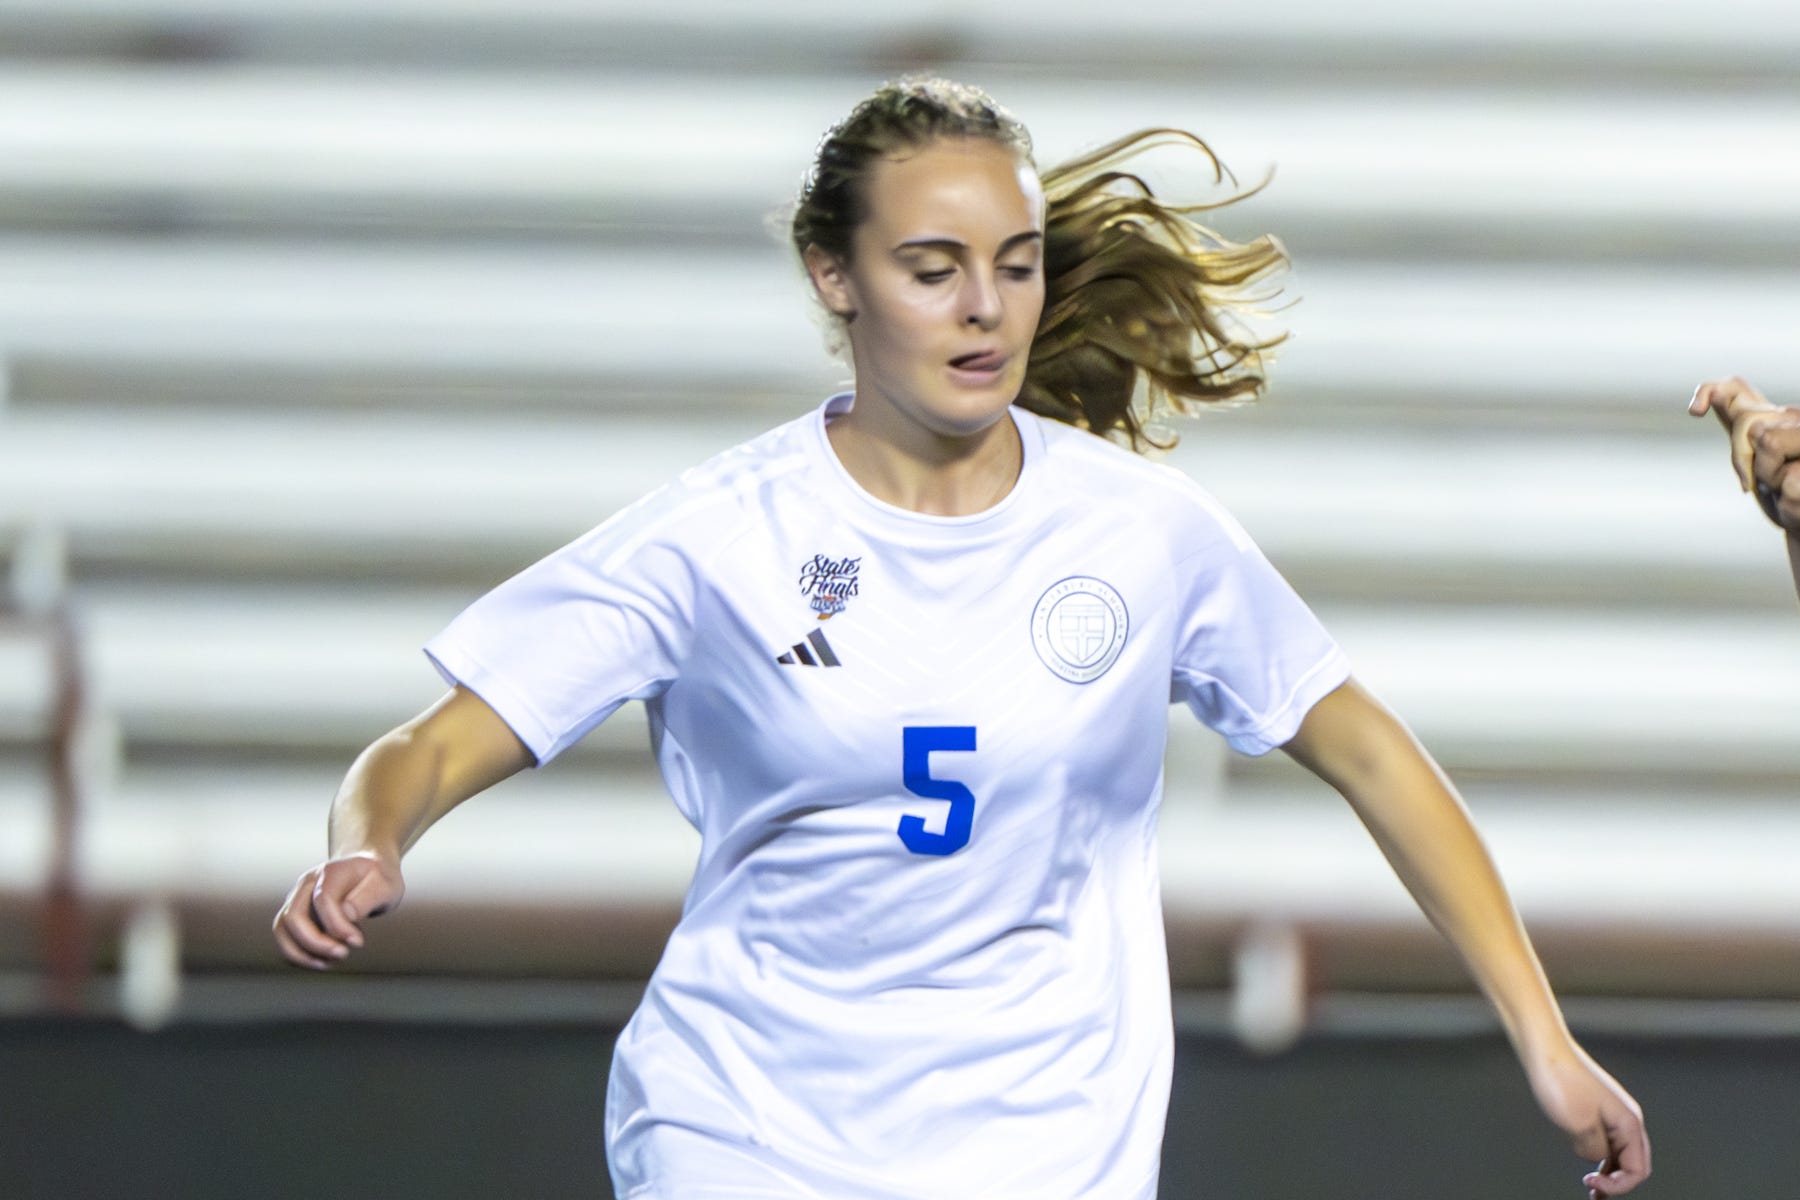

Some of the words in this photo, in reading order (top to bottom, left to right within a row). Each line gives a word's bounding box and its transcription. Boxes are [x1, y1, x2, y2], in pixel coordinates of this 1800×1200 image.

[801, 554, 862, 575] State
[799, 573, 859, 599] Finals
[897, 726, 977, 856] 5
